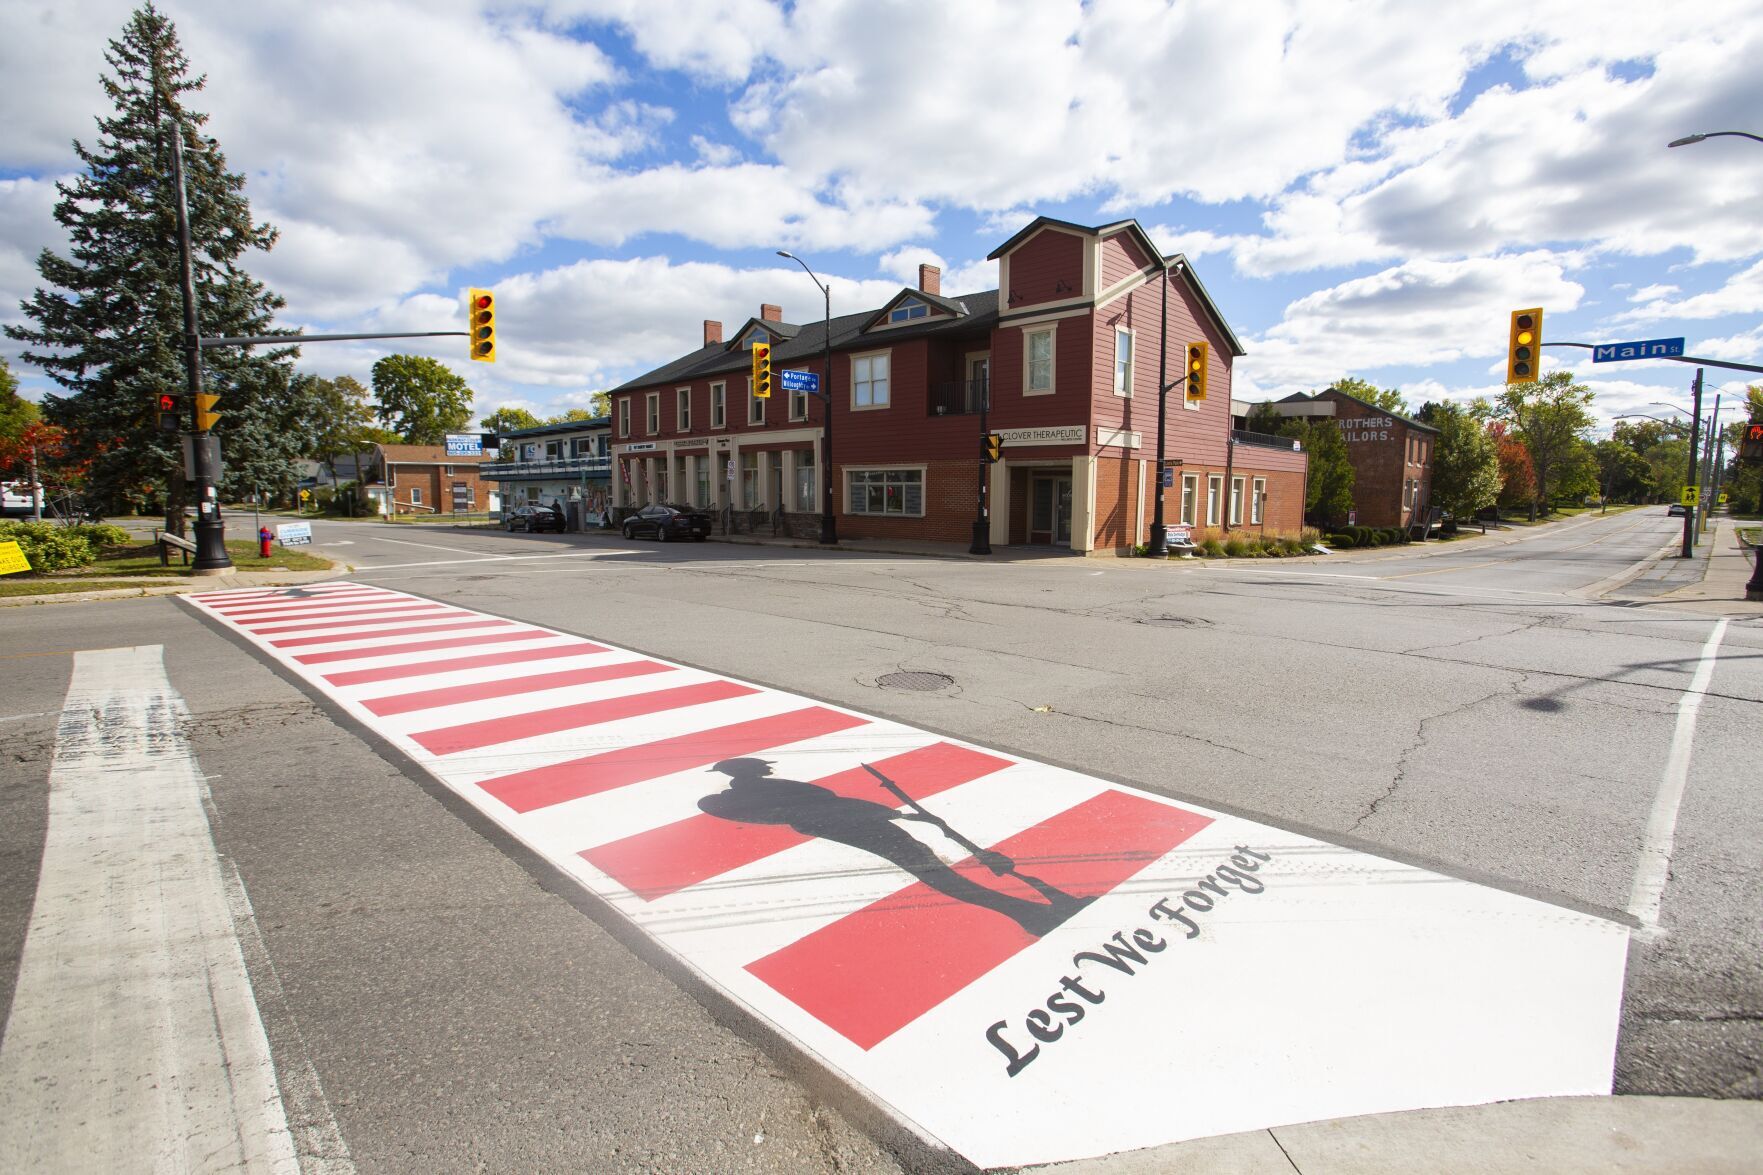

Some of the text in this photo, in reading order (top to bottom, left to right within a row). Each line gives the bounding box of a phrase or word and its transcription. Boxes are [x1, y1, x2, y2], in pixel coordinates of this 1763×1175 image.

[1597, 343, 1667, 359] Main
[1337, 417, 1393, 429] ROTHERS
[1003, 429, 1083, 441] CLOVER THERAPEUTIC
[1341, 431, 1395, 441] AILORS.
[986, 843, 1272, 1078] Lest We Forget
